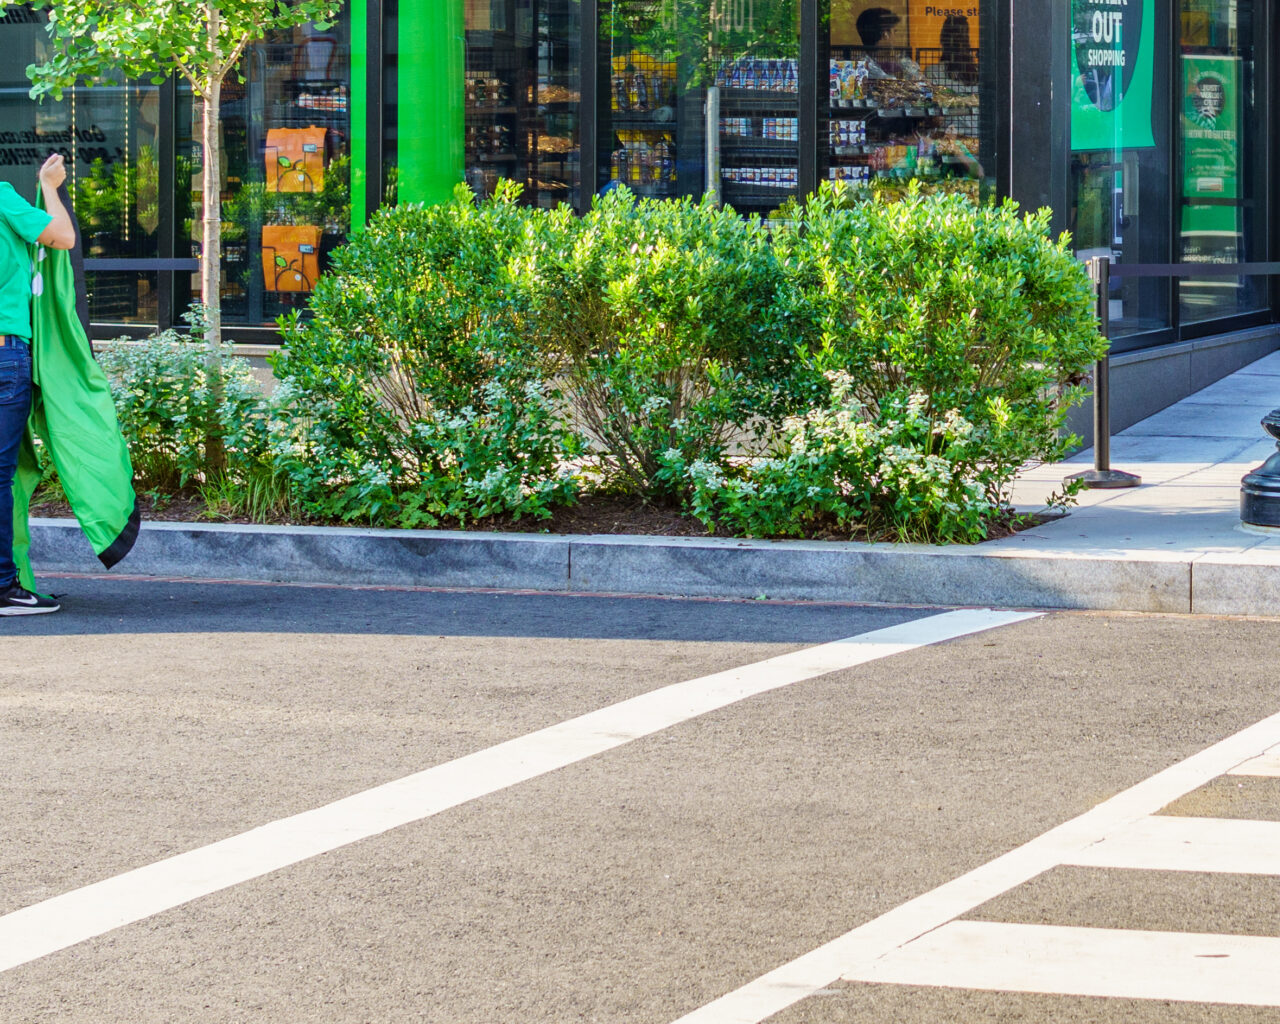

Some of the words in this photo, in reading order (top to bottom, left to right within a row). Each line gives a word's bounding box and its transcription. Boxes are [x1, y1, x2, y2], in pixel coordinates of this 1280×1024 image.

[925, 6, 963, 17] Please
[1092, 10, 1123, 43] OUT
[1088, 48, 1126, 67] SHOPPING
